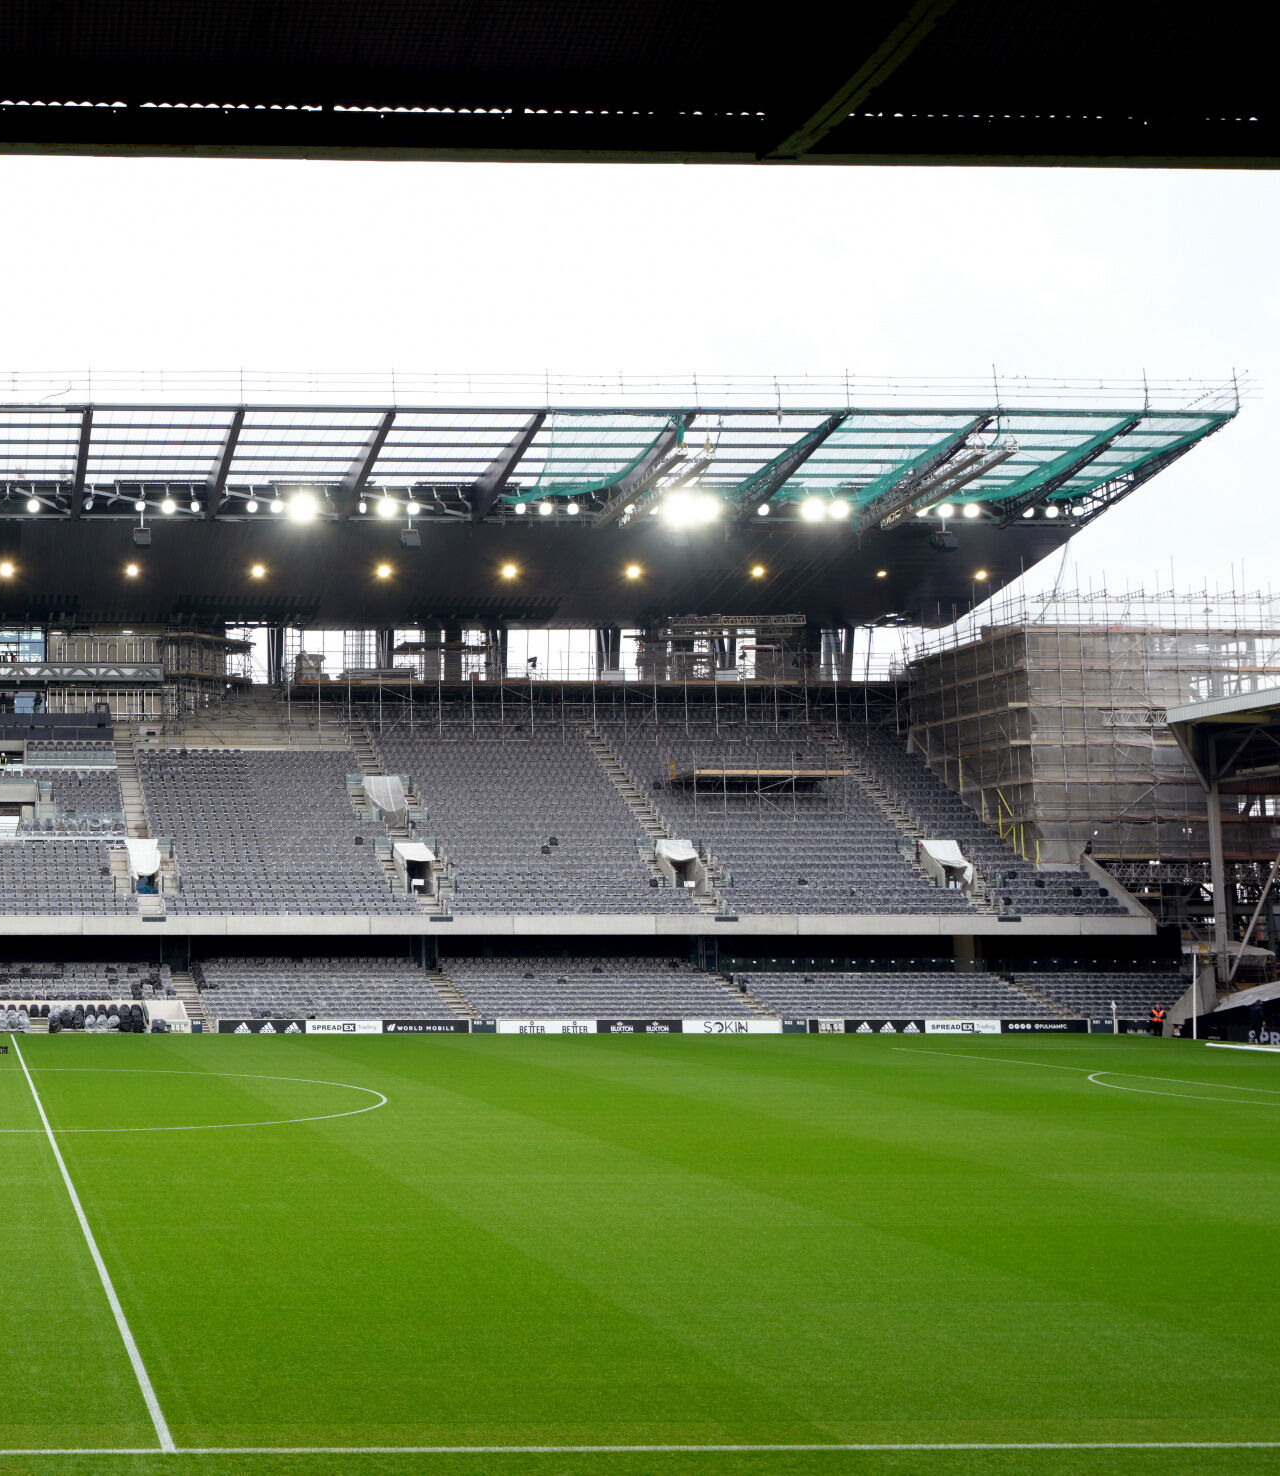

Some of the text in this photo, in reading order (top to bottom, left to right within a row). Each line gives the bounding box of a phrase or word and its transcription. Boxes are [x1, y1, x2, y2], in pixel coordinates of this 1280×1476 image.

[519, 1026, 546, 1034] BETTER
[562, 1026, 588, 1034] BETTER
[703, 1021, 748, 1033] SOKIN
